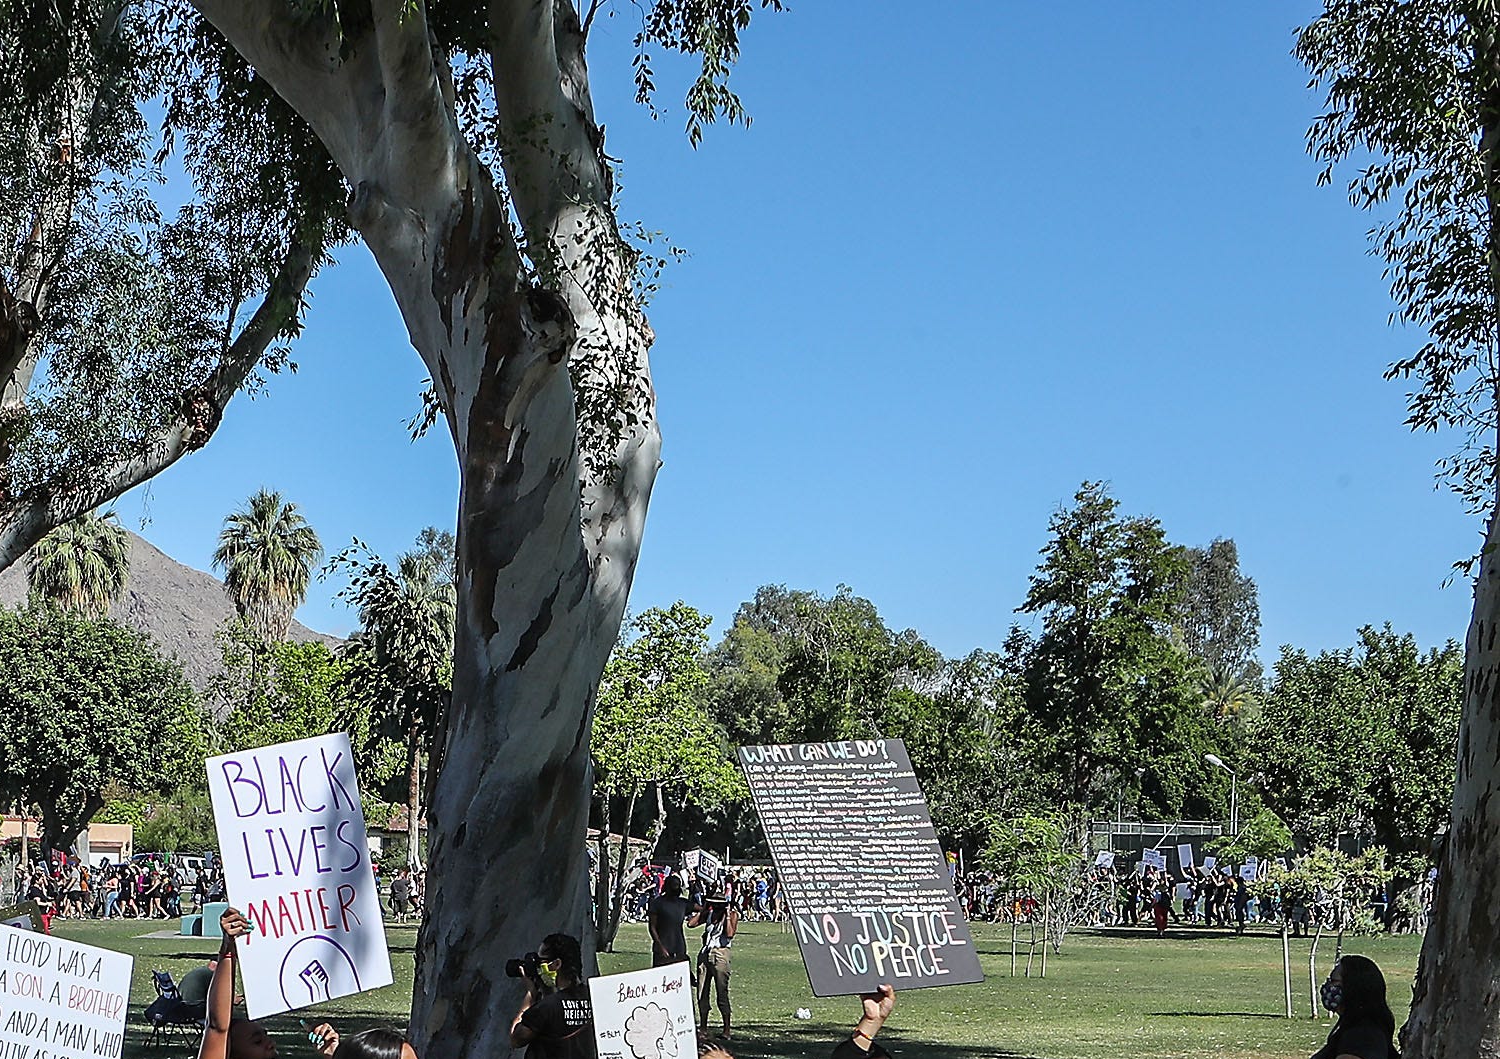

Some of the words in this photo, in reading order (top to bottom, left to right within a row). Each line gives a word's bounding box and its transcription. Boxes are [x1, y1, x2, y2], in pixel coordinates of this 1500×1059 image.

[741, 744, 794, 763] WHAT
[799, 743, 830, 761] CAN
[826, 741, 856, 759] WE
[855, 739, 889, 759] DO?
[221, 747, 355, 818] BLACK
[242, 820, 362, 880] LIVES
[245, 884, 361, 945] MATTER
[799, 914, 839, 945] NO
[853, 911, 967, 946] JUSTICE
[6, 933, 51, 968] FLOYD
[57, 947, 87, 978] WAS
[88, 957, 102, 982] A
[830, 944, 866, 977] NO
[873, 942, 950, 978] PEACE
[11, 971, 45, 1001] SON.
[49, 981, 61, 1006] A
[68, 984, 124, 1023] BROTHER.
[4, 1011, 38, 1036] AND
[36, 1017, 49, 1043] A
[53, 1020, 91, 1052] MAN
[93, 1029, 123, 1059] WHO
